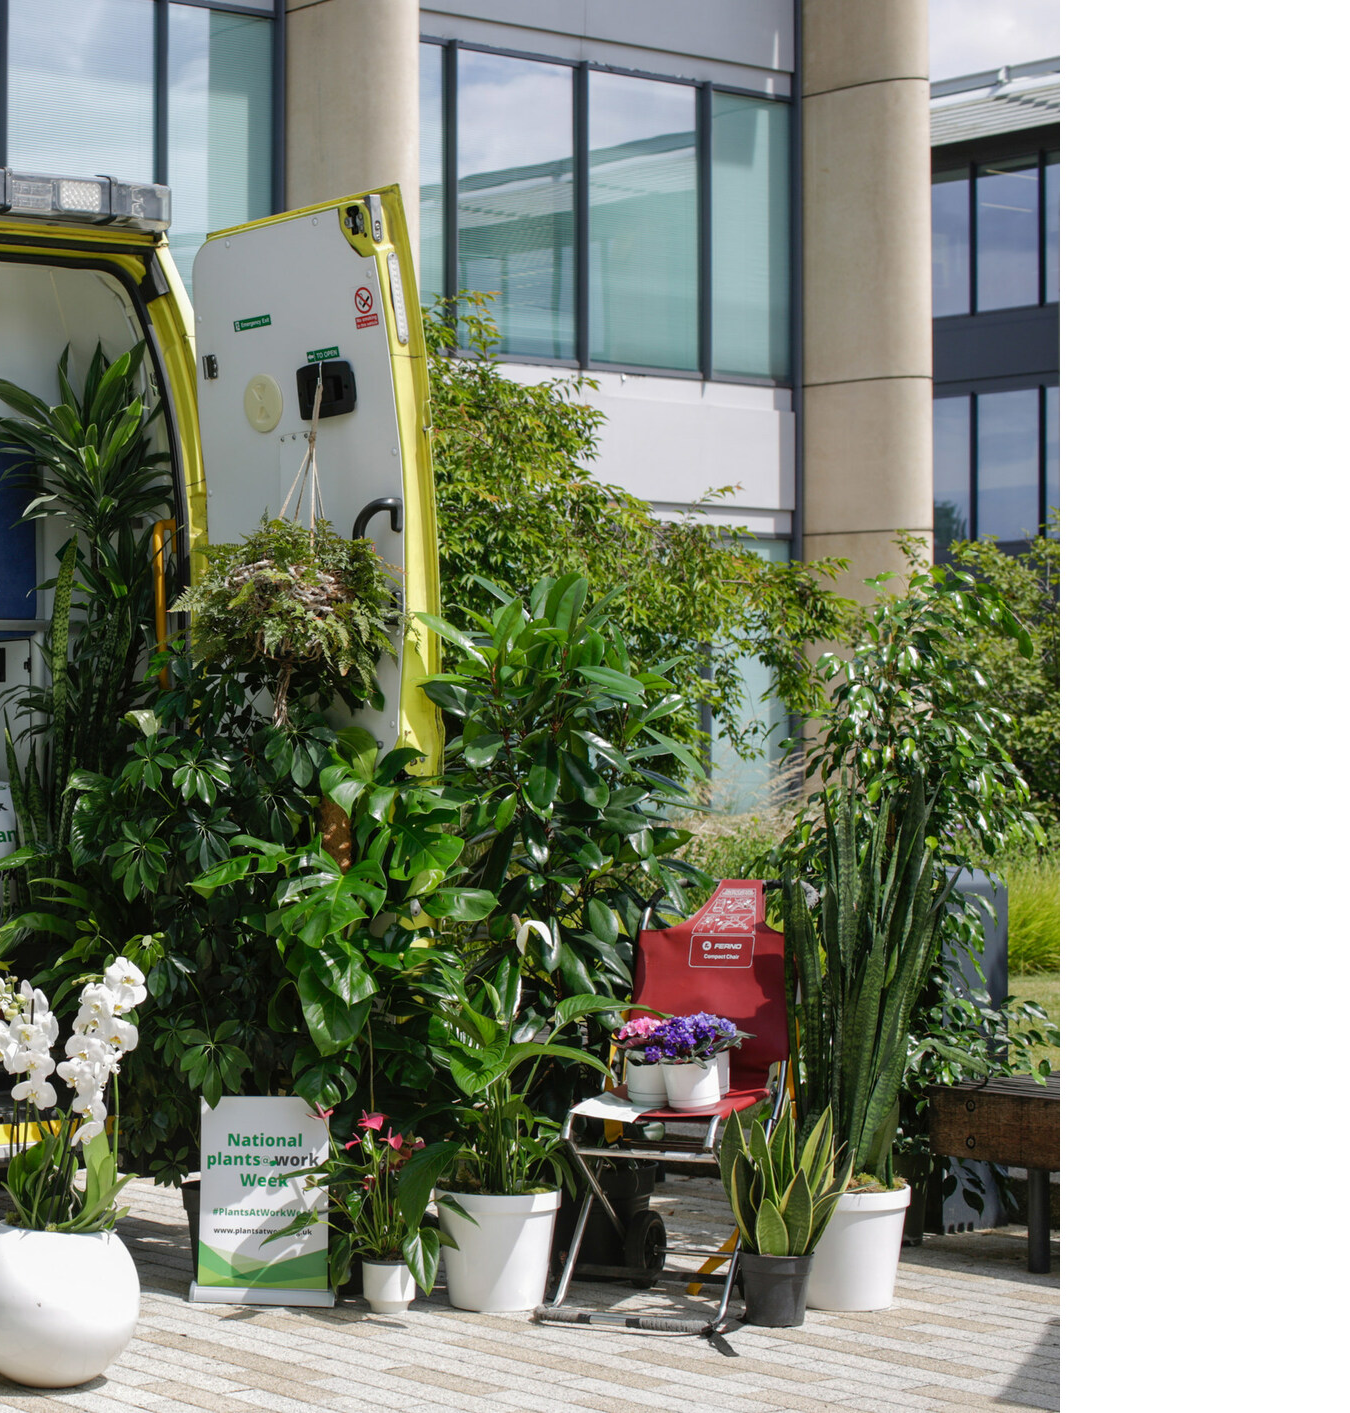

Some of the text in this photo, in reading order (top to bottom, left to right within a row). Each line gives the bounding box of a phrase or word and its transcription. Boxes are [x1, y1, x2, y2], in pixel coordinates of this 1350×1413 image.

[324, 349, 338, 357] OPEN
[228, 1133, 302, 1147] National
[240, 1173, 289, 1187] Week
[212, 1207, 311, 1217] #PlantsAtWorkWe
